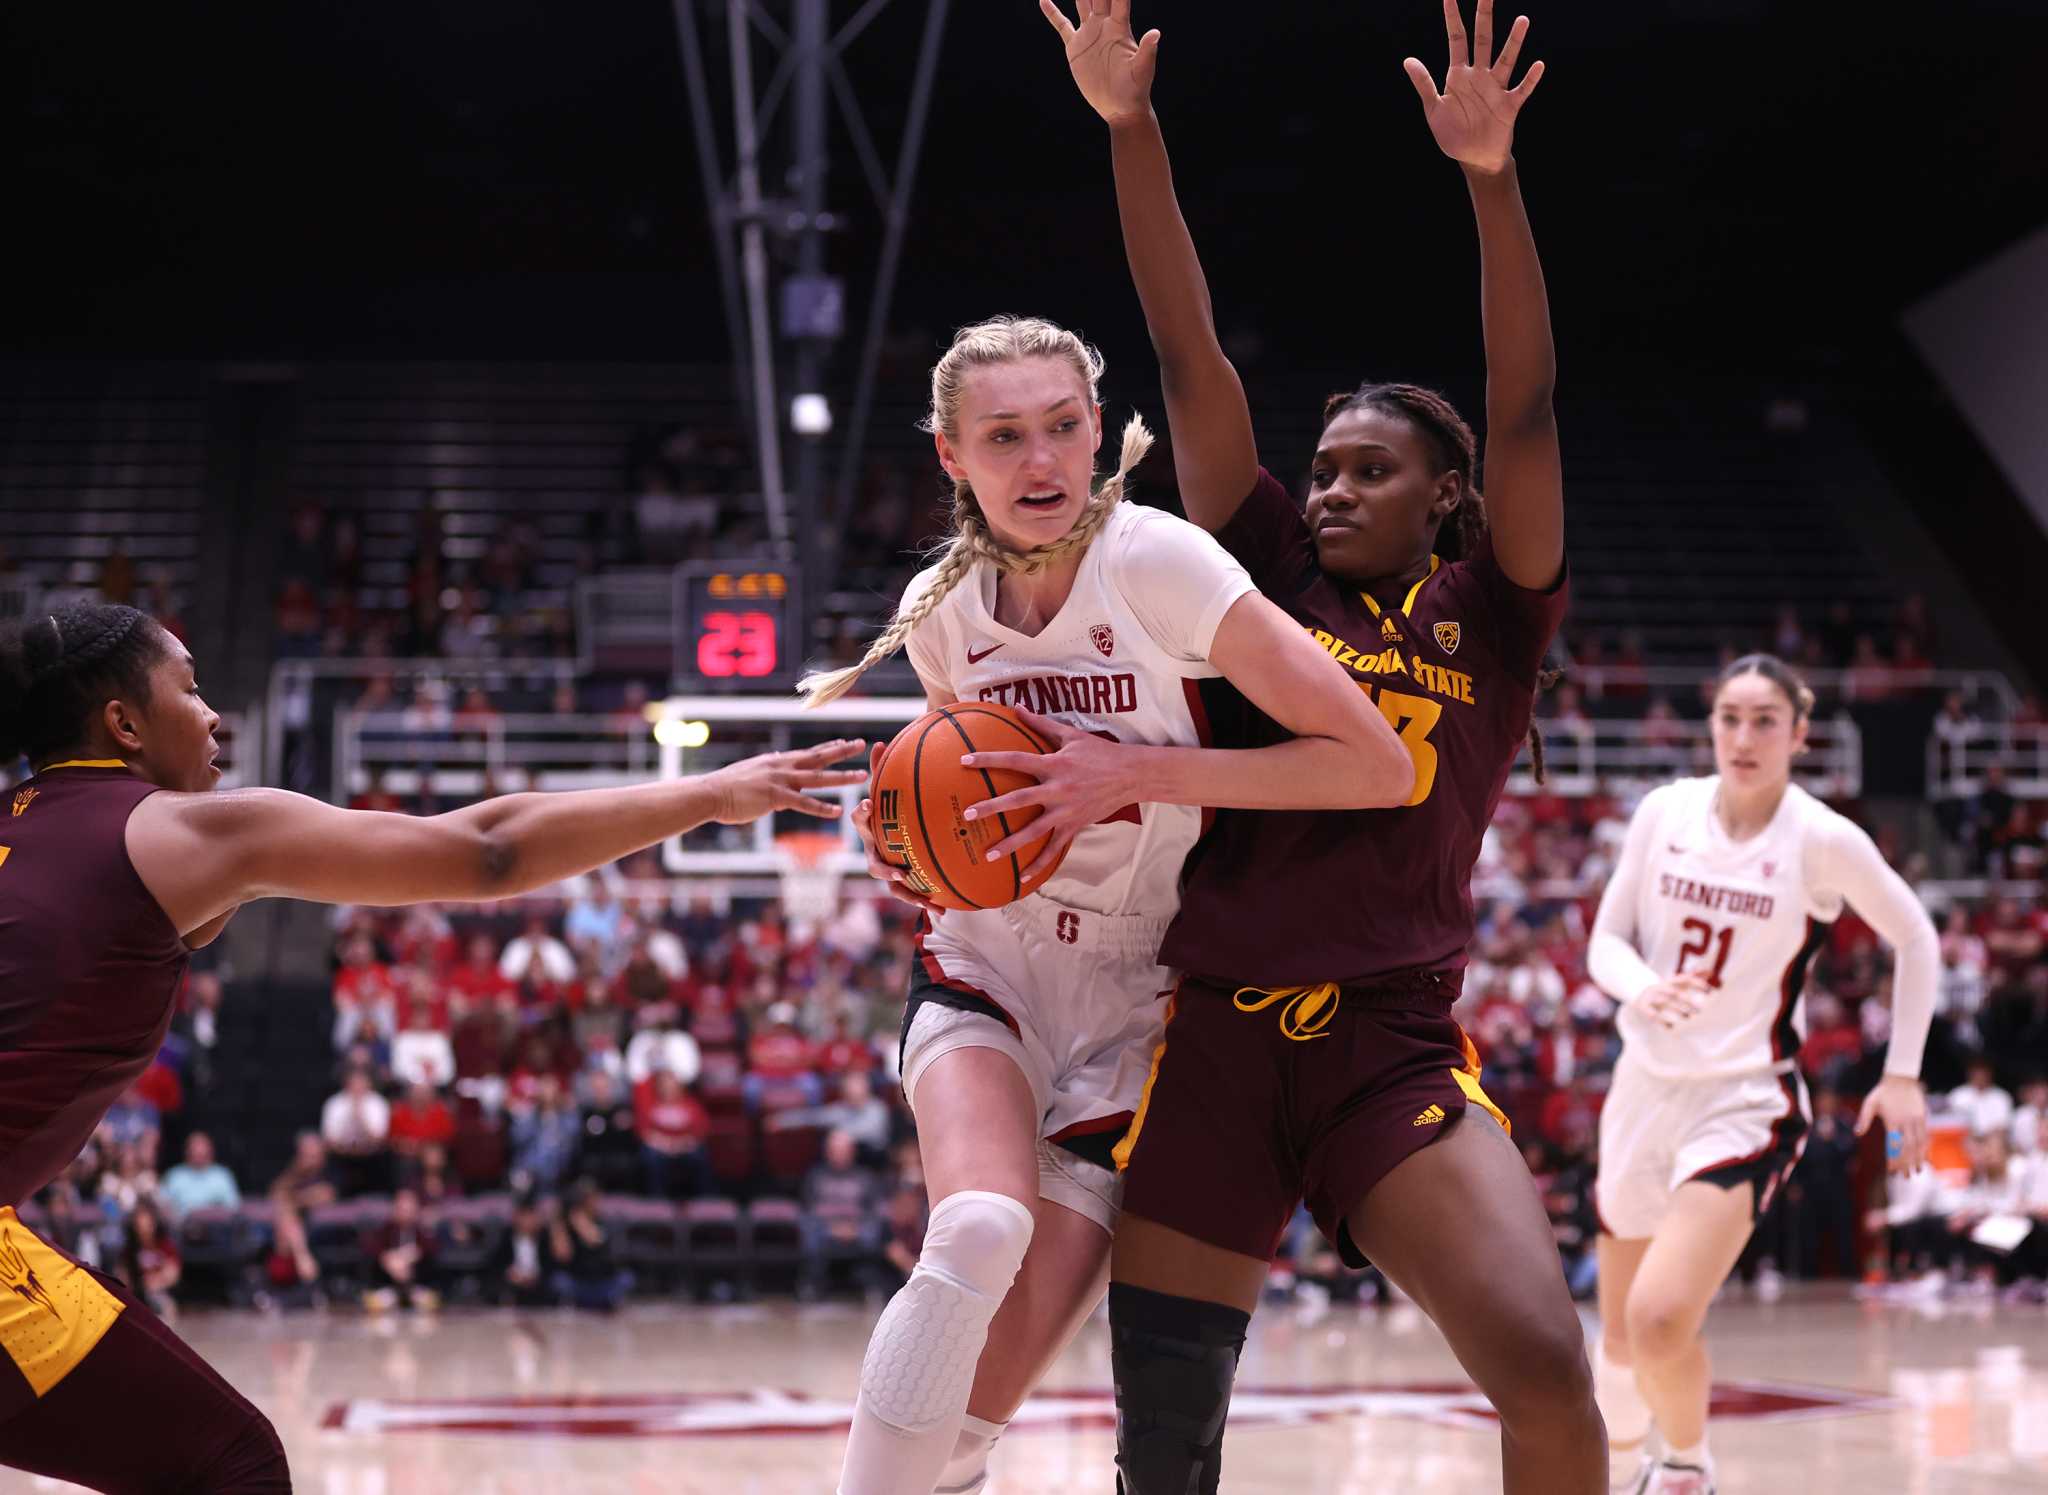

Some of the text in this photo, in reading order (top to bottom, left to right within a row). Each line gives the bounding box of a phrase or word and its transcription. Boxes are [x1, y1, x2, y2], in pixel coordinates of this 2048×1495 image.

[699, 611, 777, 677] 23
[1436, 624, 1458, 641] PAC
[1442, 635, 1455, 648] 12
[1304, 627, 1475, 705] RIZONA STATE
[1355, 682, 1443, 806] 3
[1660, 872, 1775, 920] STANFORD
[1676, 917, 1733, 989] 21
